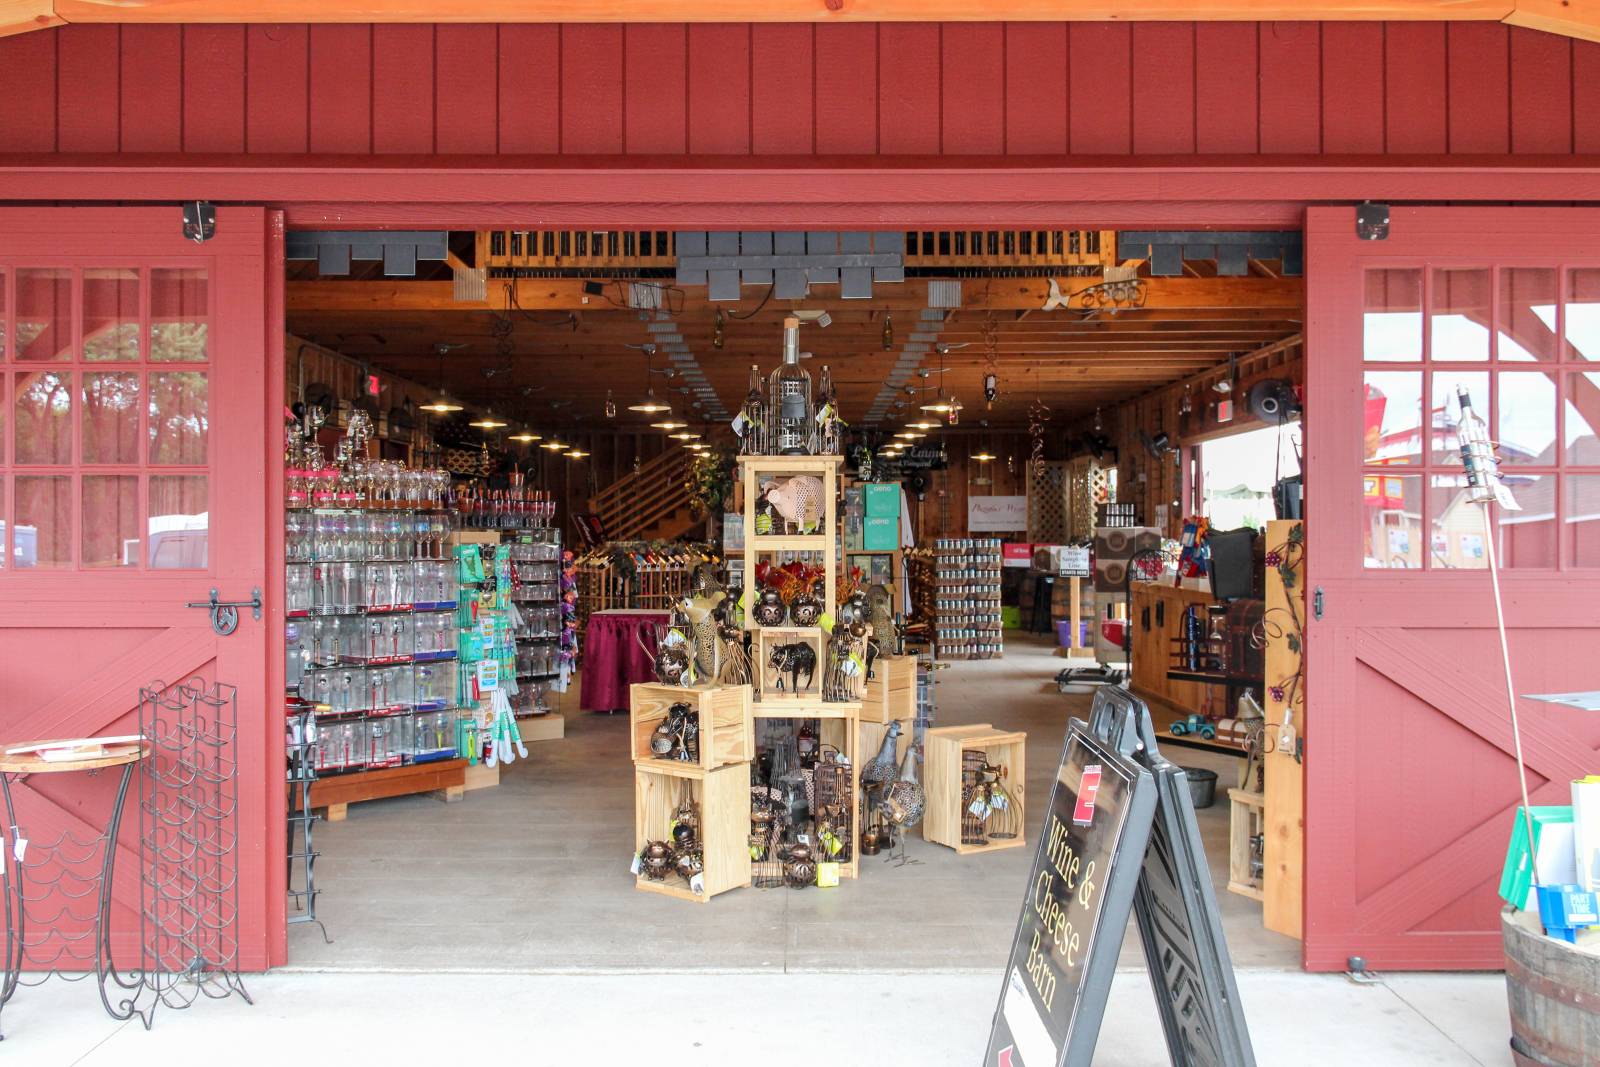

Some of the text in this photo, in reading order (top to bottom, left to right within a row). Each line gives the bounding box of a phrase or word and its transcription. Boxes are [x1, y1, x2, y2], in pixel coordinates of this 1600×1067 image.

[1047, 814, 1096, 909] Wine &
[1035, 870, 1079, 966] Cheese
[1026, 928, 1056, 1013] Barn
